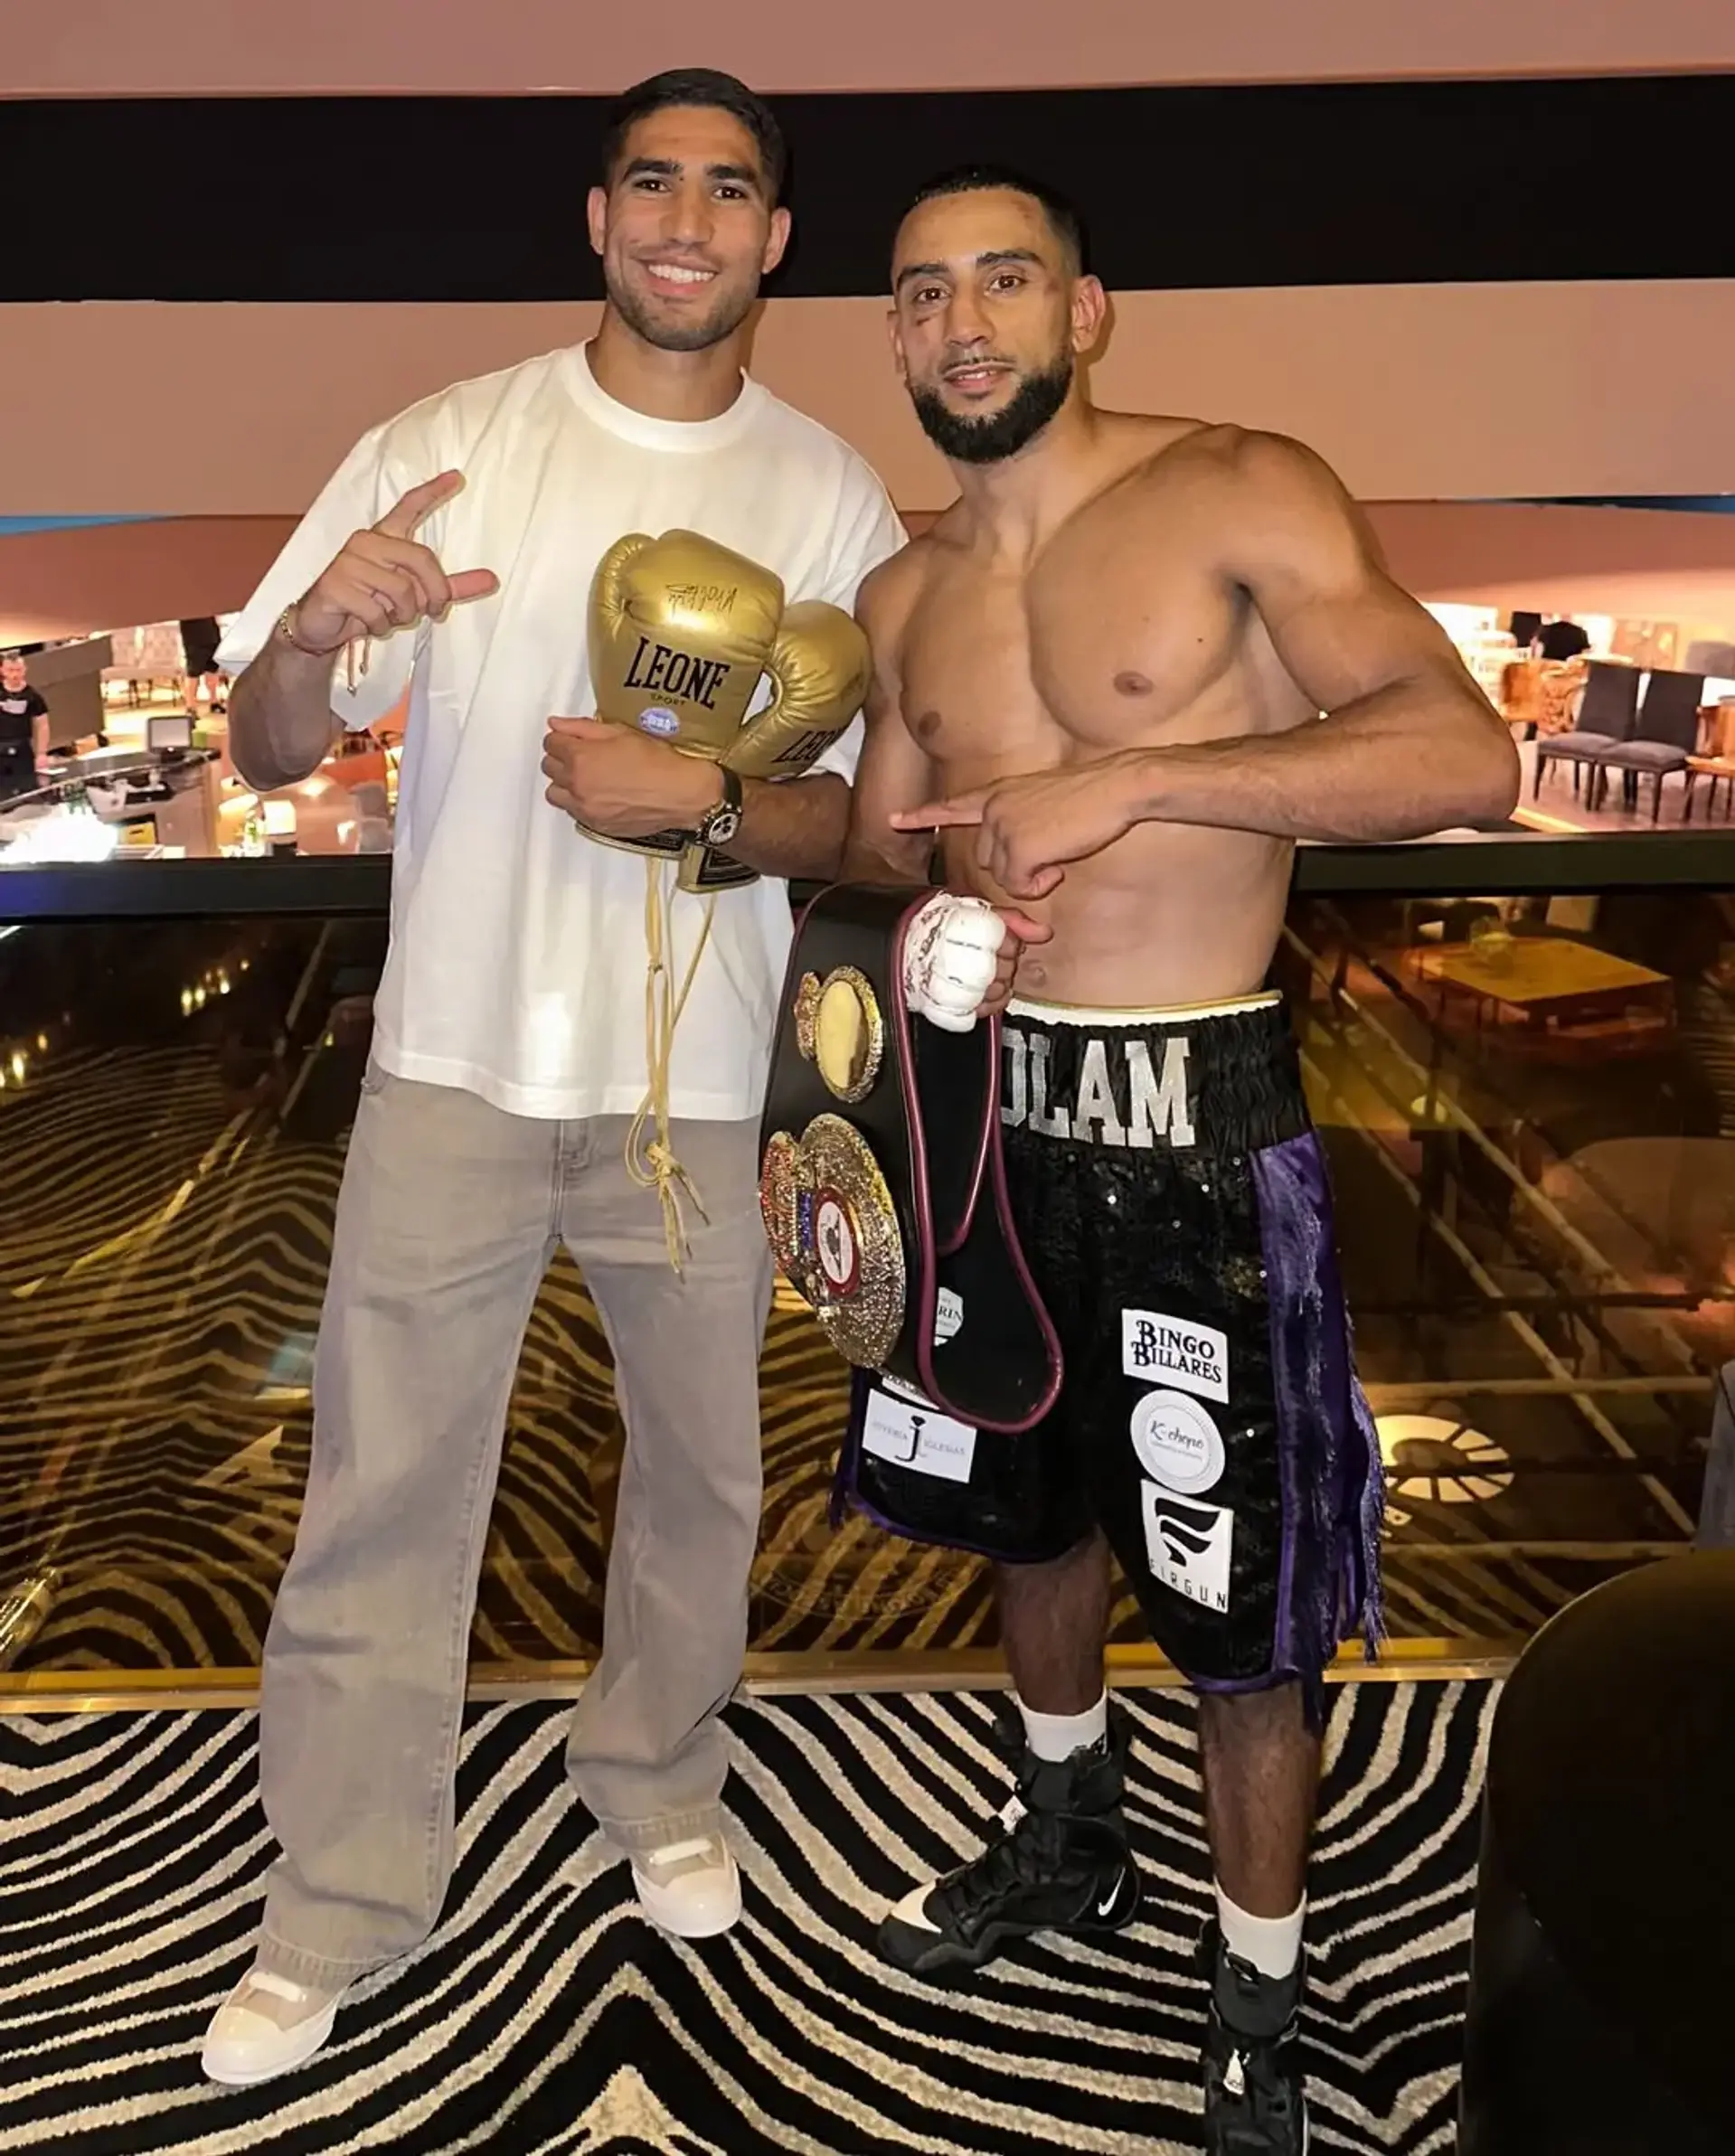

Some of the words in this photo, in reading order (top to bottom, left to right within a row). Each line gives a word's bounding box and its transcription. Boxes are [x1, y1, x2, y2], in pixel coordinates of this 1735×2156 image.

[623, 636, 731, 711] LEONE
[1136, 1319, 1215, 1360] BINGO
[1130, 1341, 1222, 1384] BILLARES
